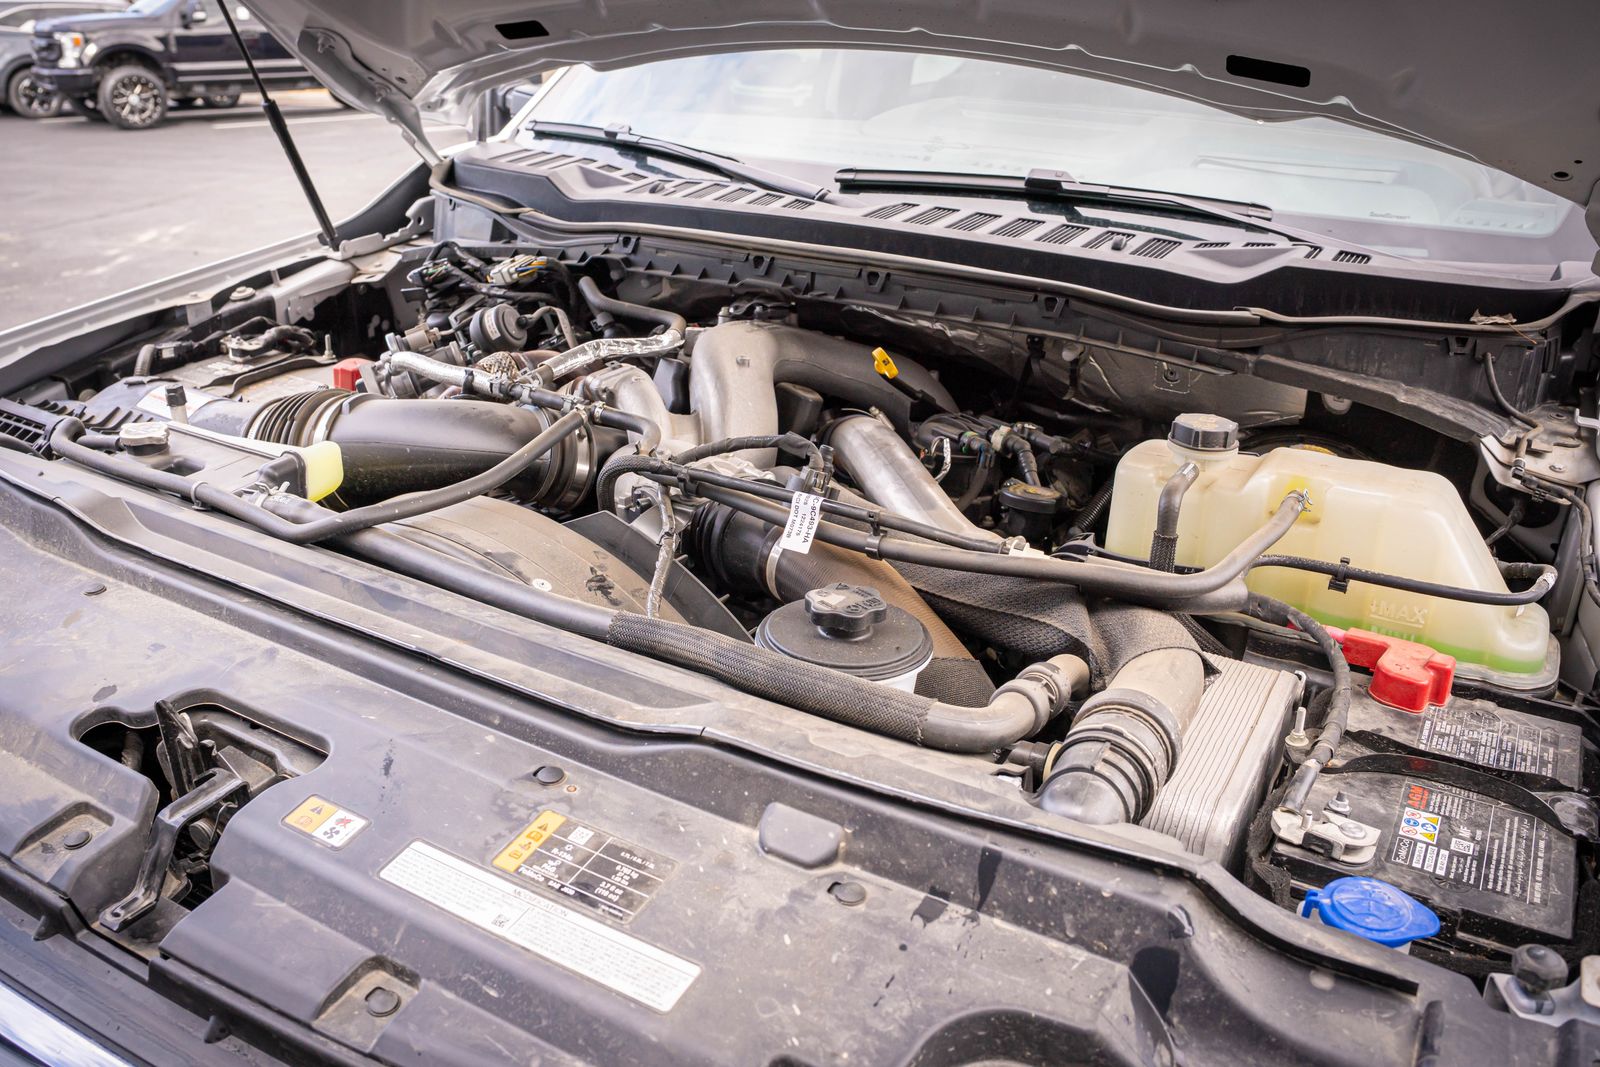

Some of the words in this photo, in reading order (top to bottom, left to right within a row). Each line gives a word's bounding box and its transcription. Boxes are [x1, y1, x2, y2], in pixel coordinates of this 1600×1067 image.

[552, 848, 573, 861] R-134a
[1396, 839, 1409, 863] FoMoCo
[519, 867, 544, 881] FoMoCo
